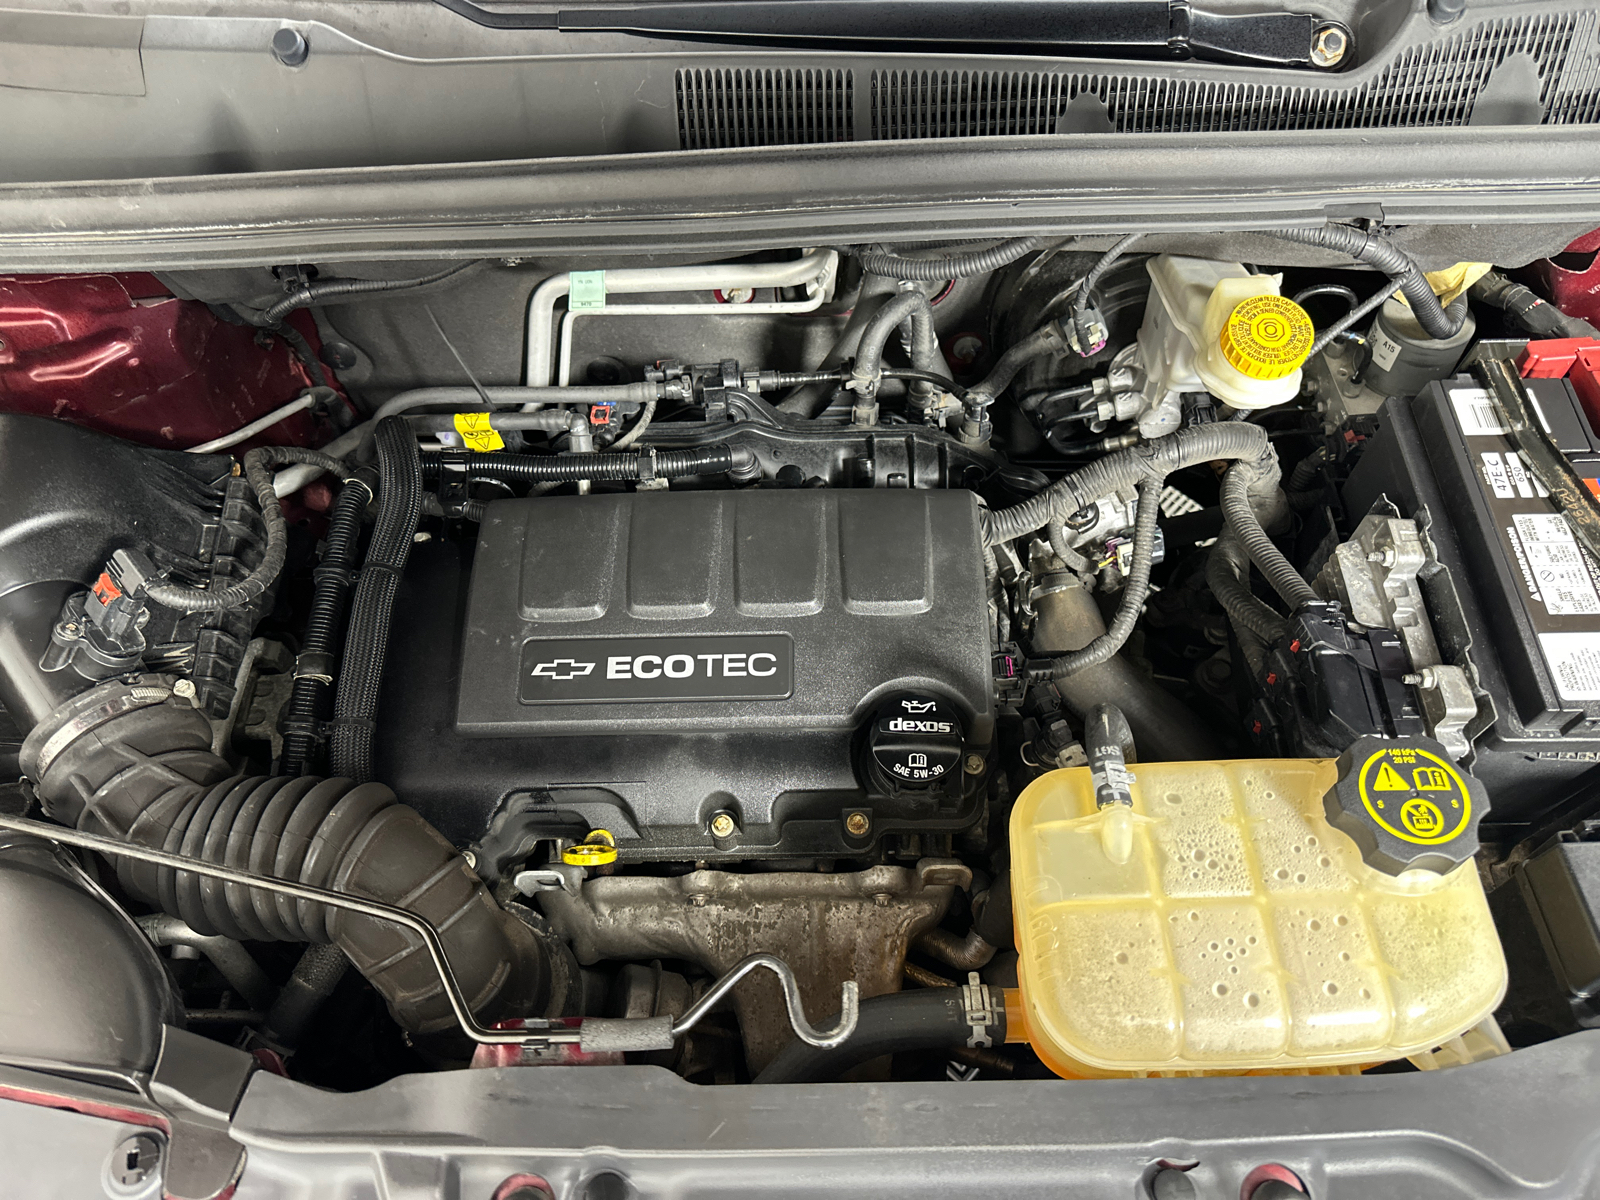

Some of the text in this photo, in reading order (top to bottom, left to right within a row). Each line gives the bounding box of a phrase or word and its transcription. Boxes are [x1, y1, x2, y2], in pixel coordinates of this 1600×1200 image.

[1281, 299, 1292, 307] CAP
[1382, 340, 1396, 354] A15
[1487, 459, 1507, 491] 47E-C
[1513, 467, 1525, 482] 650
[1506, 526, 1537, 593] DANGER/POISON
[606, 653, 777, 680] ECOTEC
[889, 717, 951, 733] dexos
[1392, 756, 1416, 764] 20 PSI
[893, 763, 944, 778] SAE 5W-30
[1377, 799, 1385, 809] S
[1451, 799, 1459, 809] S
